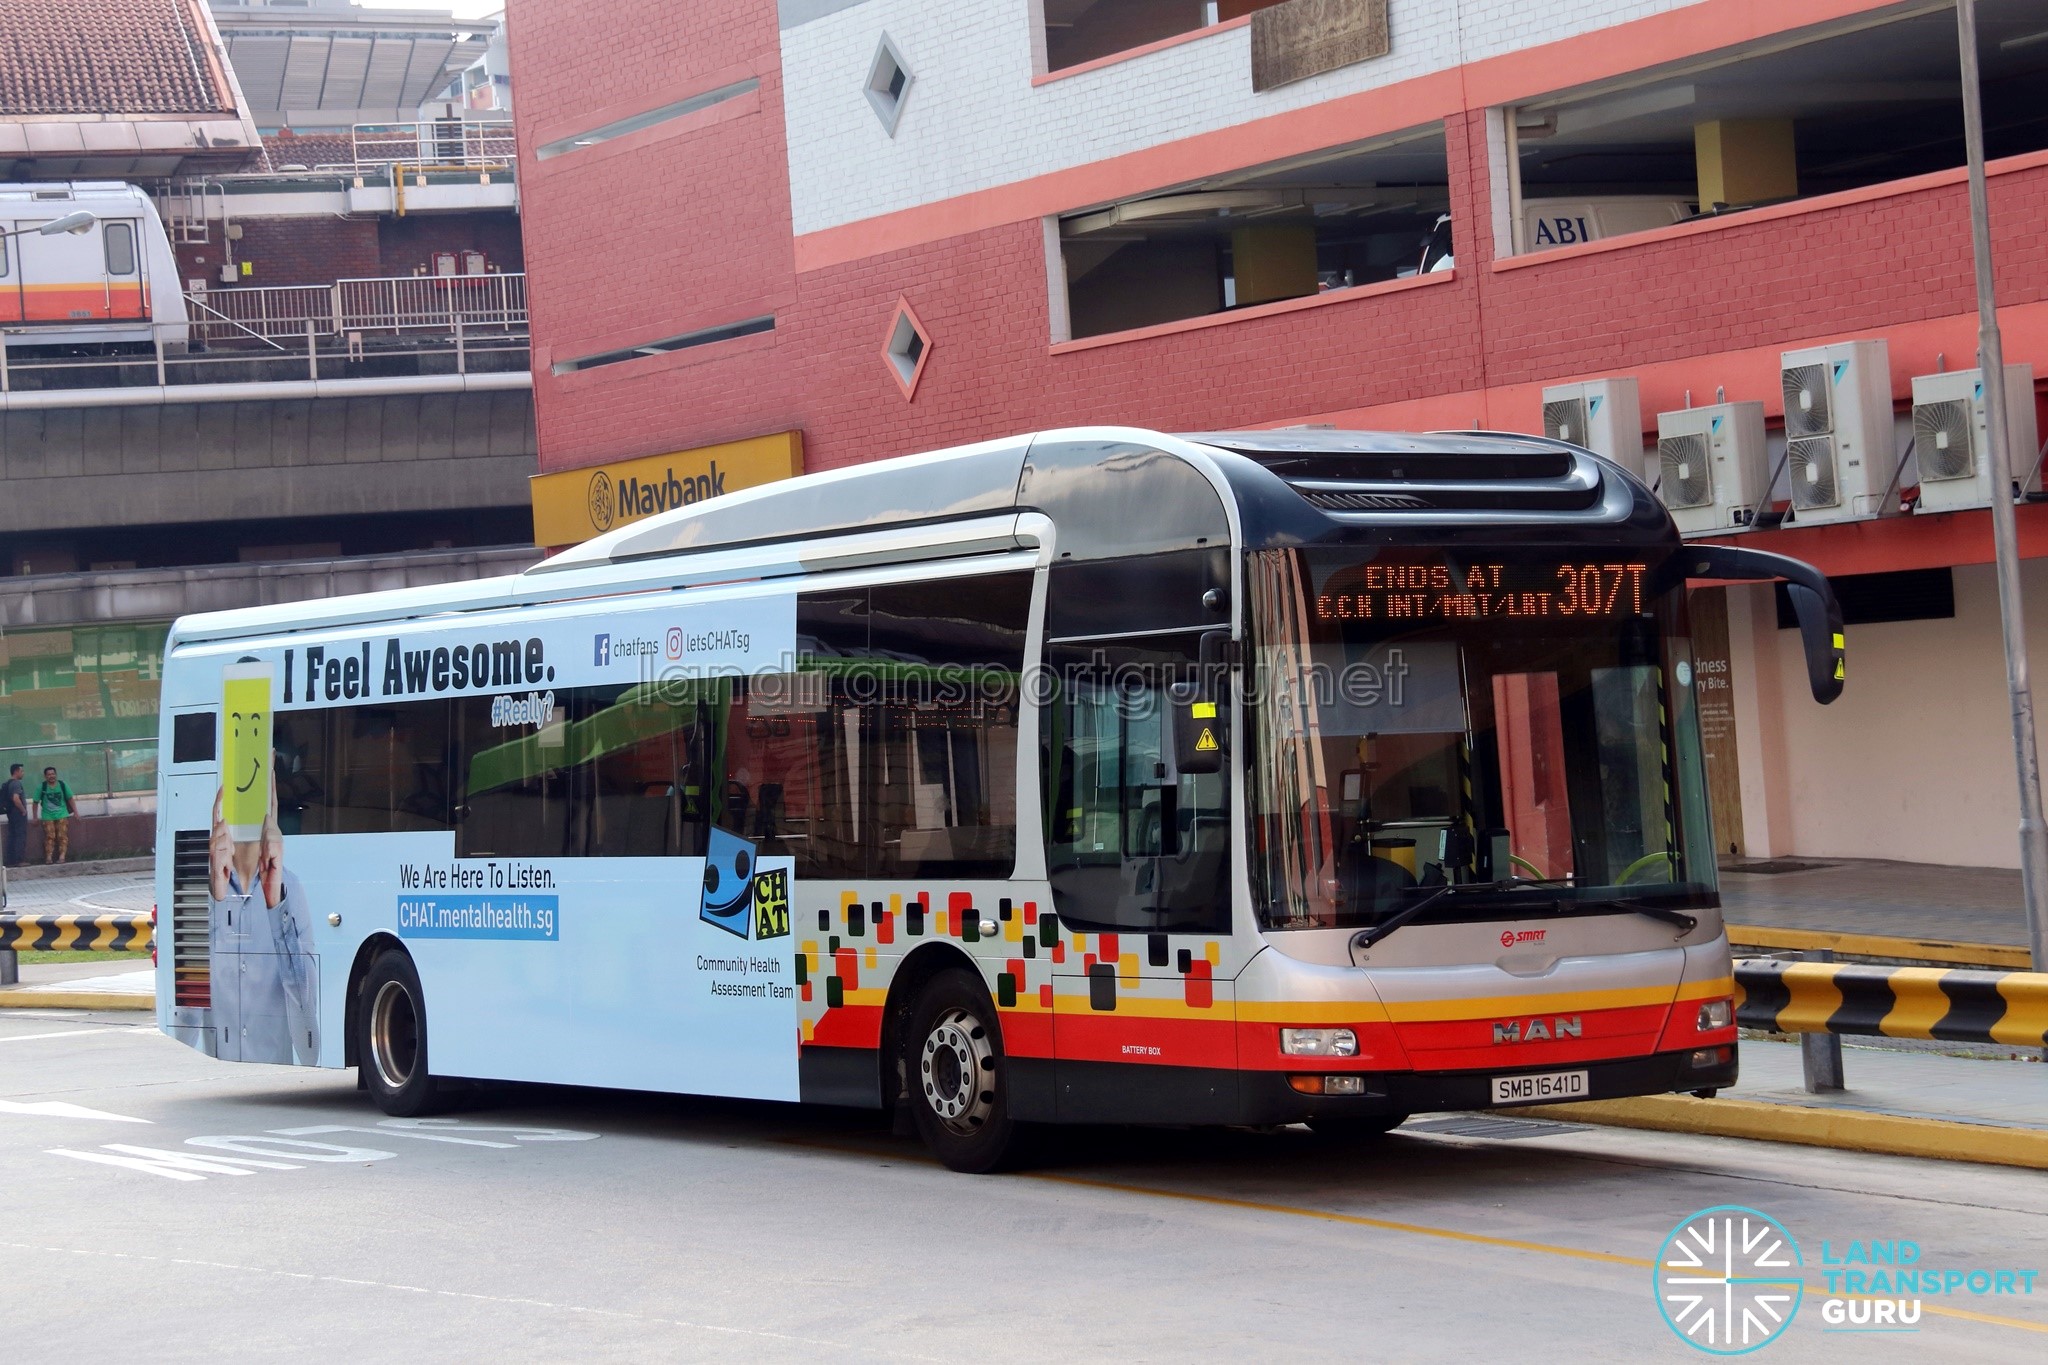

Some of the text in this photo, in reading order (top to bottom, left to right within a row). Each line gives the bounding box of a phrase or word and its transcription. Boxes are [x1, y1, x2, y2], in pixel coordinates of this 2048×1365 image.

[618, 460, 726, 518] Maybank
[1366, 564, 1504, 589] ENDS AT
[1556, 563, 1647, 615] 307T
[613, 637, 659, 658] chatfans
[686, 629, 751, 654] letsCHATsg
[283, 637, 555, 704] I Feel Awesome.
[1695, 658, 1728, 674] dness
[1708, 677, 1730, 690] Bite.
[492, 690, 555, 729] #Really?
[400, 862, 556, 889] We Are Here To Listen.
[400, 902, 554, 937] CHAT.mentalhealth.sg
[1516, 930, 1547, 942] SMRT
[696, 955, 781, 976] Community Health
[711, 980, 794, 999] Assessment Team
[1493, 1016, 1582, 1044] MAN
[1122, 1045, 1161, 1056] BATTERY BOX
